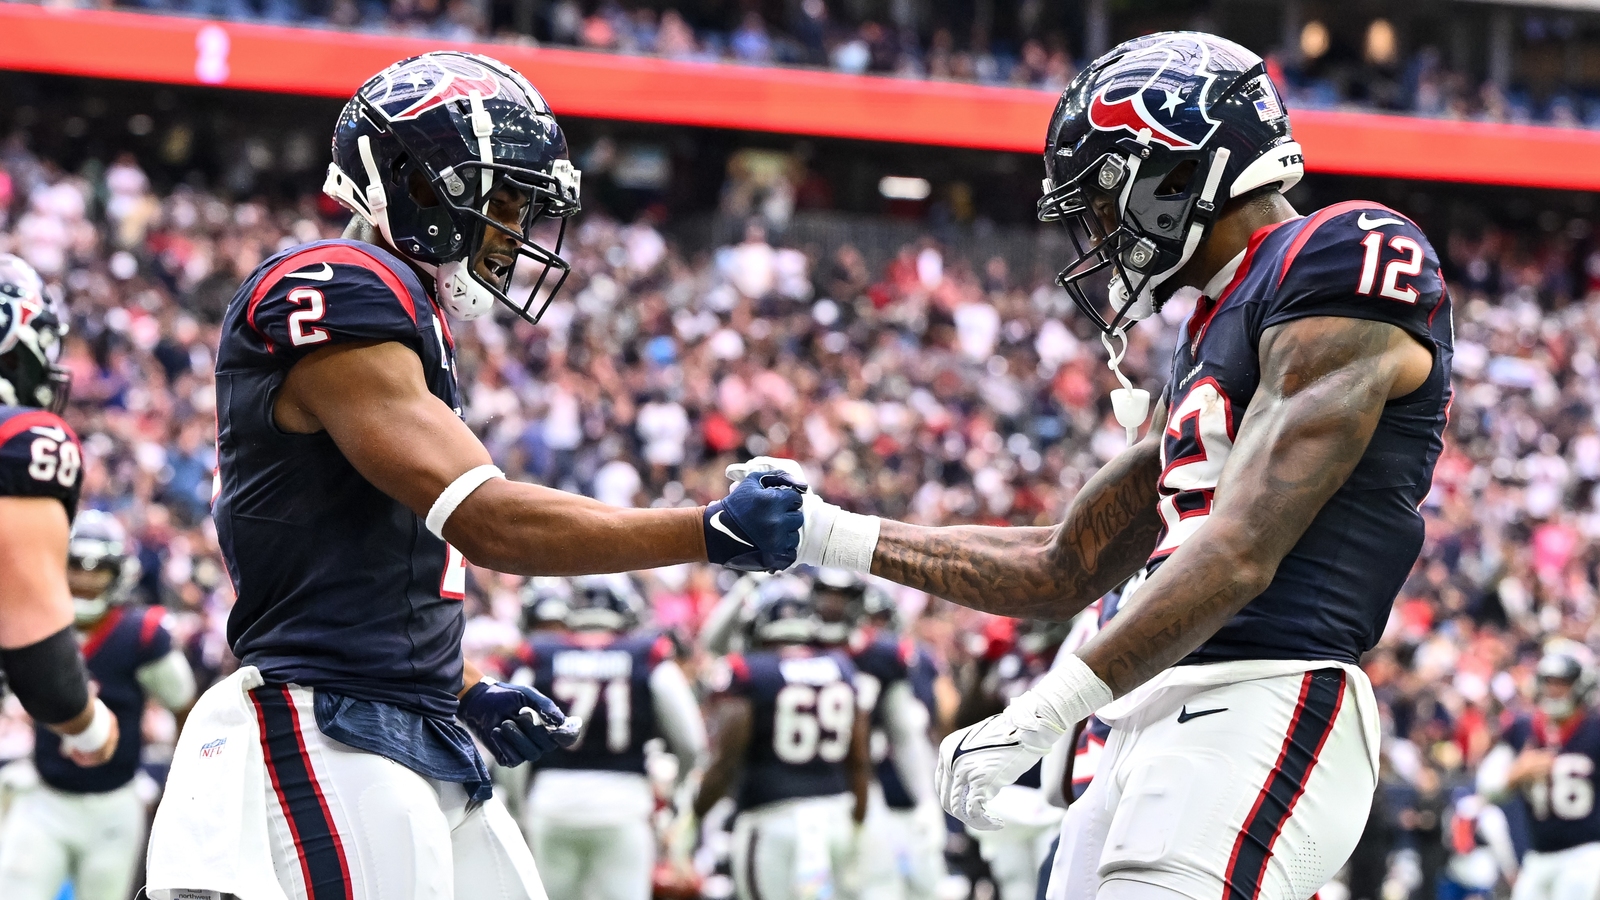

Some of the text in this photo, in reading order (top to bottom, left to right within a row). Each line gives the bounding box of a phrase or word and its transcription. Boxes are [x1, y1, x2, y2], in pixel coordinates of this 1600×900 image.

[1355, 231, 1424, 305] 12
[286, 285, 331, 347] 2
[28, 436, 80, 488] 68
[552, 679, 631, 753] 71
[773, 683, 854, 764] 69
